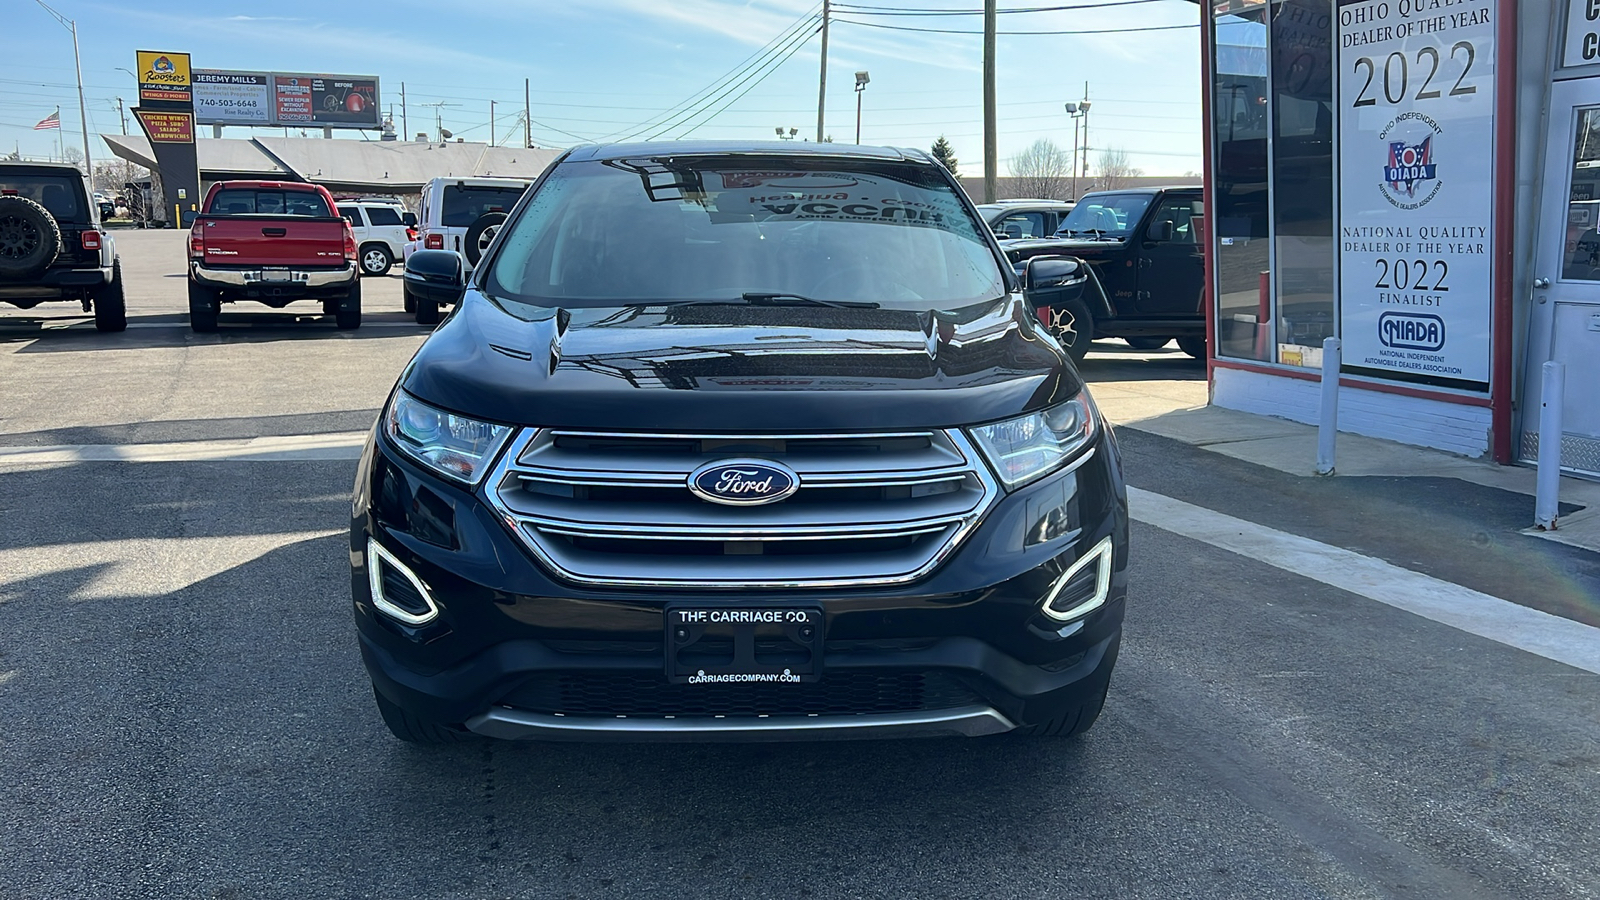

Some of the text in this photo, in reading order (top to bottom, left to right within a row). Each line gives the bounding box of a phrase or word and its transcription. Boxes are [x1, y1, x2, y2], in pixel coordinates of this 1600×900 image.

[1341, 3, 1389, 27] OHIO
[1343, 8, 1490, 48] DEALER OF THE YEAR
[144, 70, 186, 83] Roosters
[1352, 41, 1477, 108] 2022
[200, 99, 257, 107] 740-503-6648
[1379, 112, 1443, 140] OHIO INDEPENDENT
[1390, 166, 1427, 180] OIADA
[1378, 180, 1443, 210] AUTOMOBILE DEALERS ASSOCIATION
[1343, 226, 1487, 240] NATIONAL QUALITY
[1344, 242, 1484, 254] DEALER OF THE YEAR
[1374, 258, 1450, 292] 2022
[1115, 290, 1132, 298] Jeep
[1380, 292, 1442, 307] FINALIST
[1384, 320, 1438, 343] NIADA
[1380, 350, 1445, 363] NATIONAL INDEPENDENT
[1364, 358, 1462, 374] AUTOMOBILE DEALERS ASSOCIATION
[715, 470, 773, 493] Ford
[679, 611, 809, 622] THE CARRIAGE CO.
[688, 674, 800, 684] CARRIAGECOMPANY.COM
